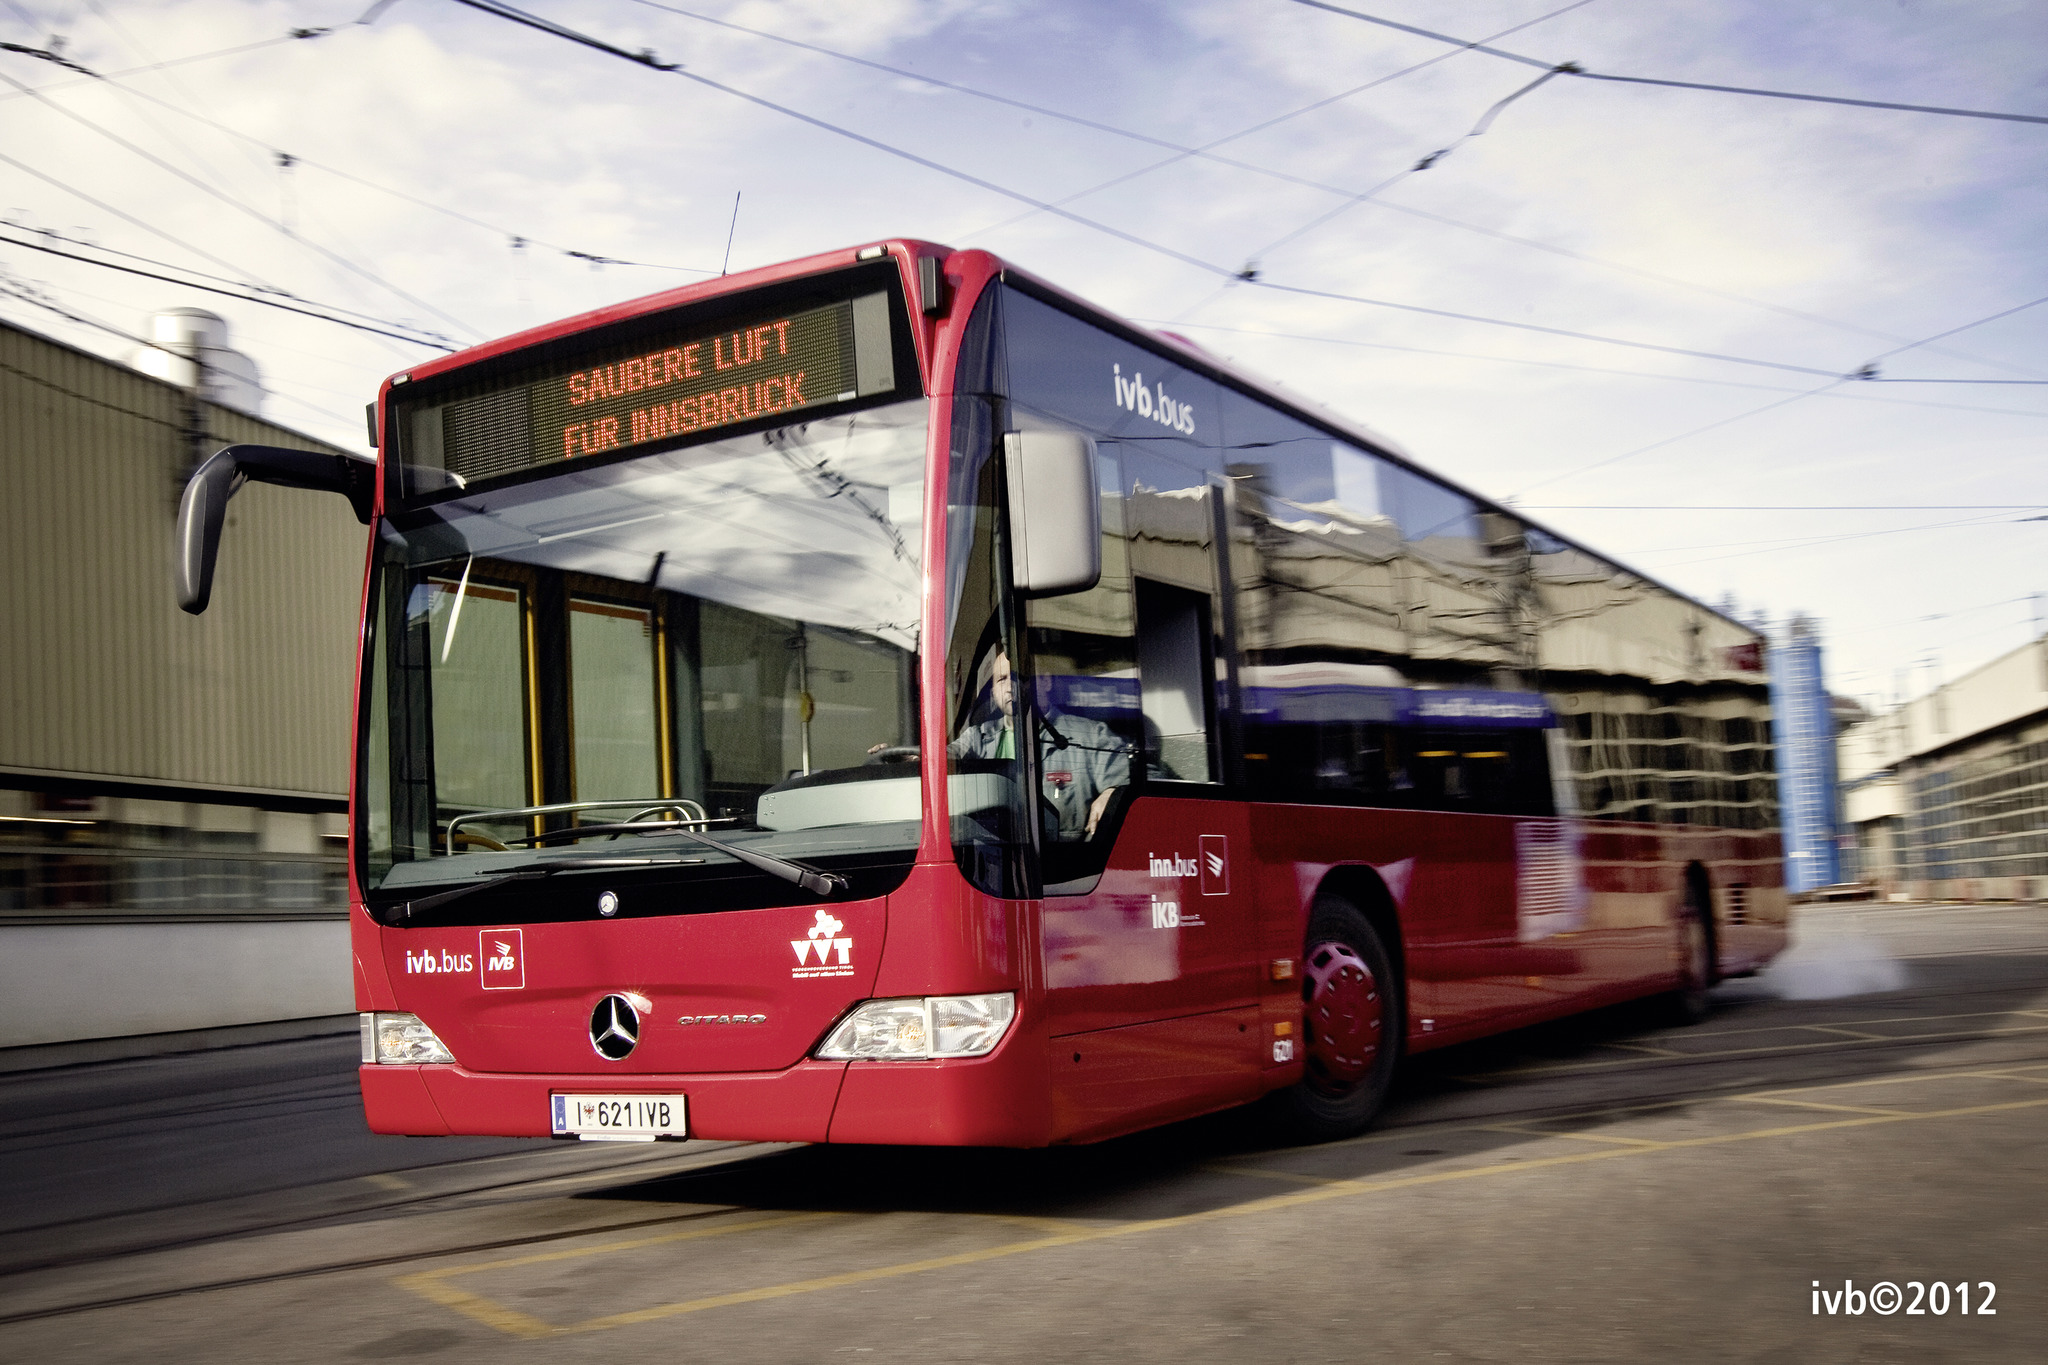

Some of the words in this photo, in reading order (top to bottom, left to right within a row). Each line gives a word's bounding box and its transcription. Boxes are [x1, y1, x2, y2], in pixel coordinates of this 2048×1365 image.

[569, 343, 702, 406] SAUBERE
[714, 319, 790, 371] LUFT
[1113, 363, 1195, 435] ivb.bus
[563, 415, 620, 458] FÜR
[630, 371, 807, 444] INNSBRUCK
[1149, 852, 1198, 877] inn.bus
[406, 948, 473, 974] ivb.bus
[488, 956, 515, 972] IVB
[790, 937, 853, 966] VVT
[677, 1014, 767, 1025] CITARO
[598, 1101, 632, 1127] 621
[638, 1101, 671, 1127] IVB
